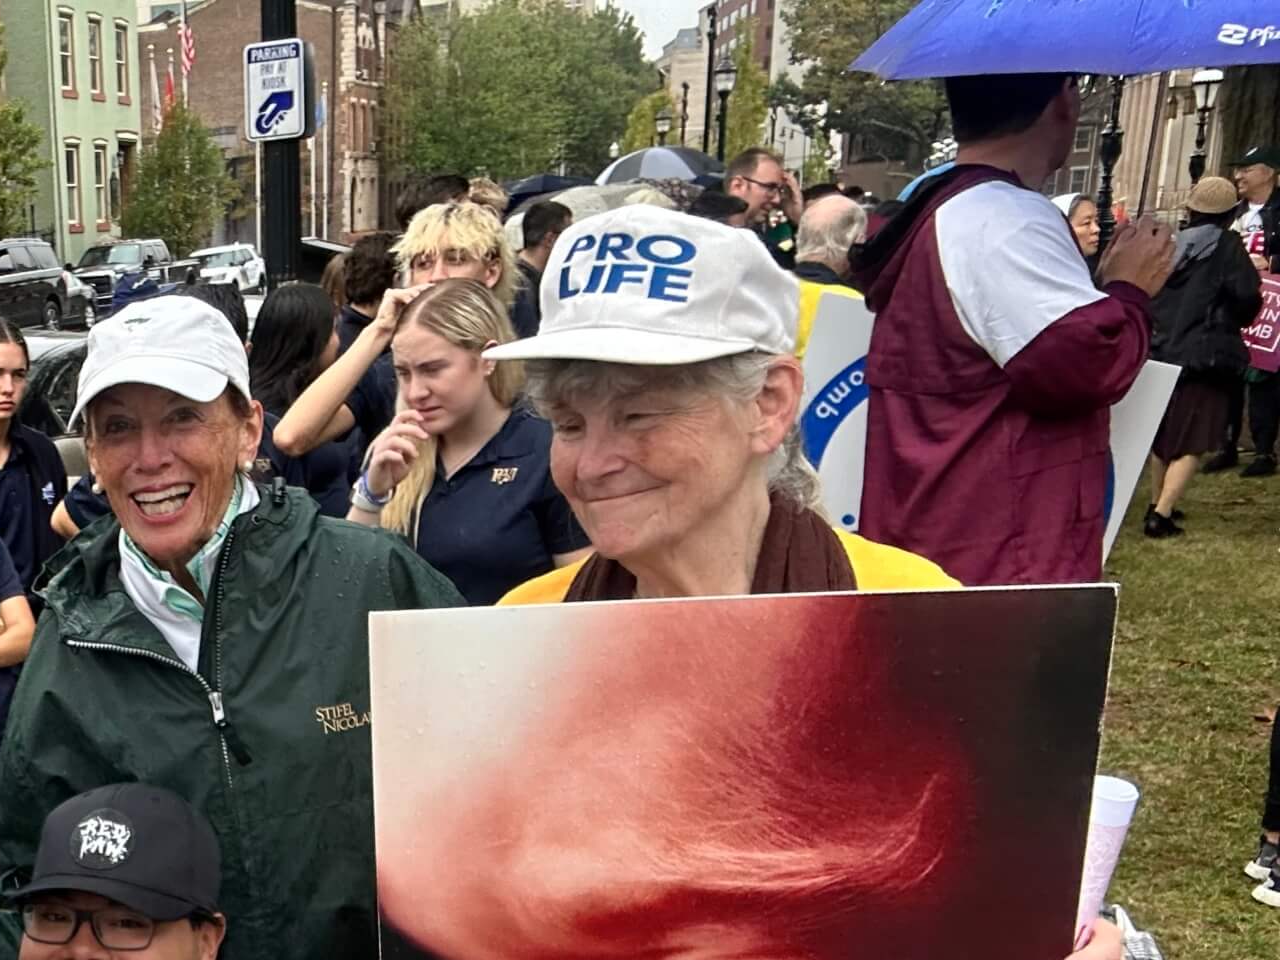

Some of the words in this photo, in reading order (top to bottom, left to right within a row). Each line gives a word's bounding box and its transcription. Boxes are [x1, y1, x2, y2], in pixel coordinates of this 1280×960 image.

[250, 44, 297, 62] PARKING
[562, 232, 697, 265] PRO
[559, 264, 693, 303] LIFE
[815, 371, 865, 418] omb
[315, 703, 355, 722] STIFEL
[323, 713, 371, 734] NICOLA
